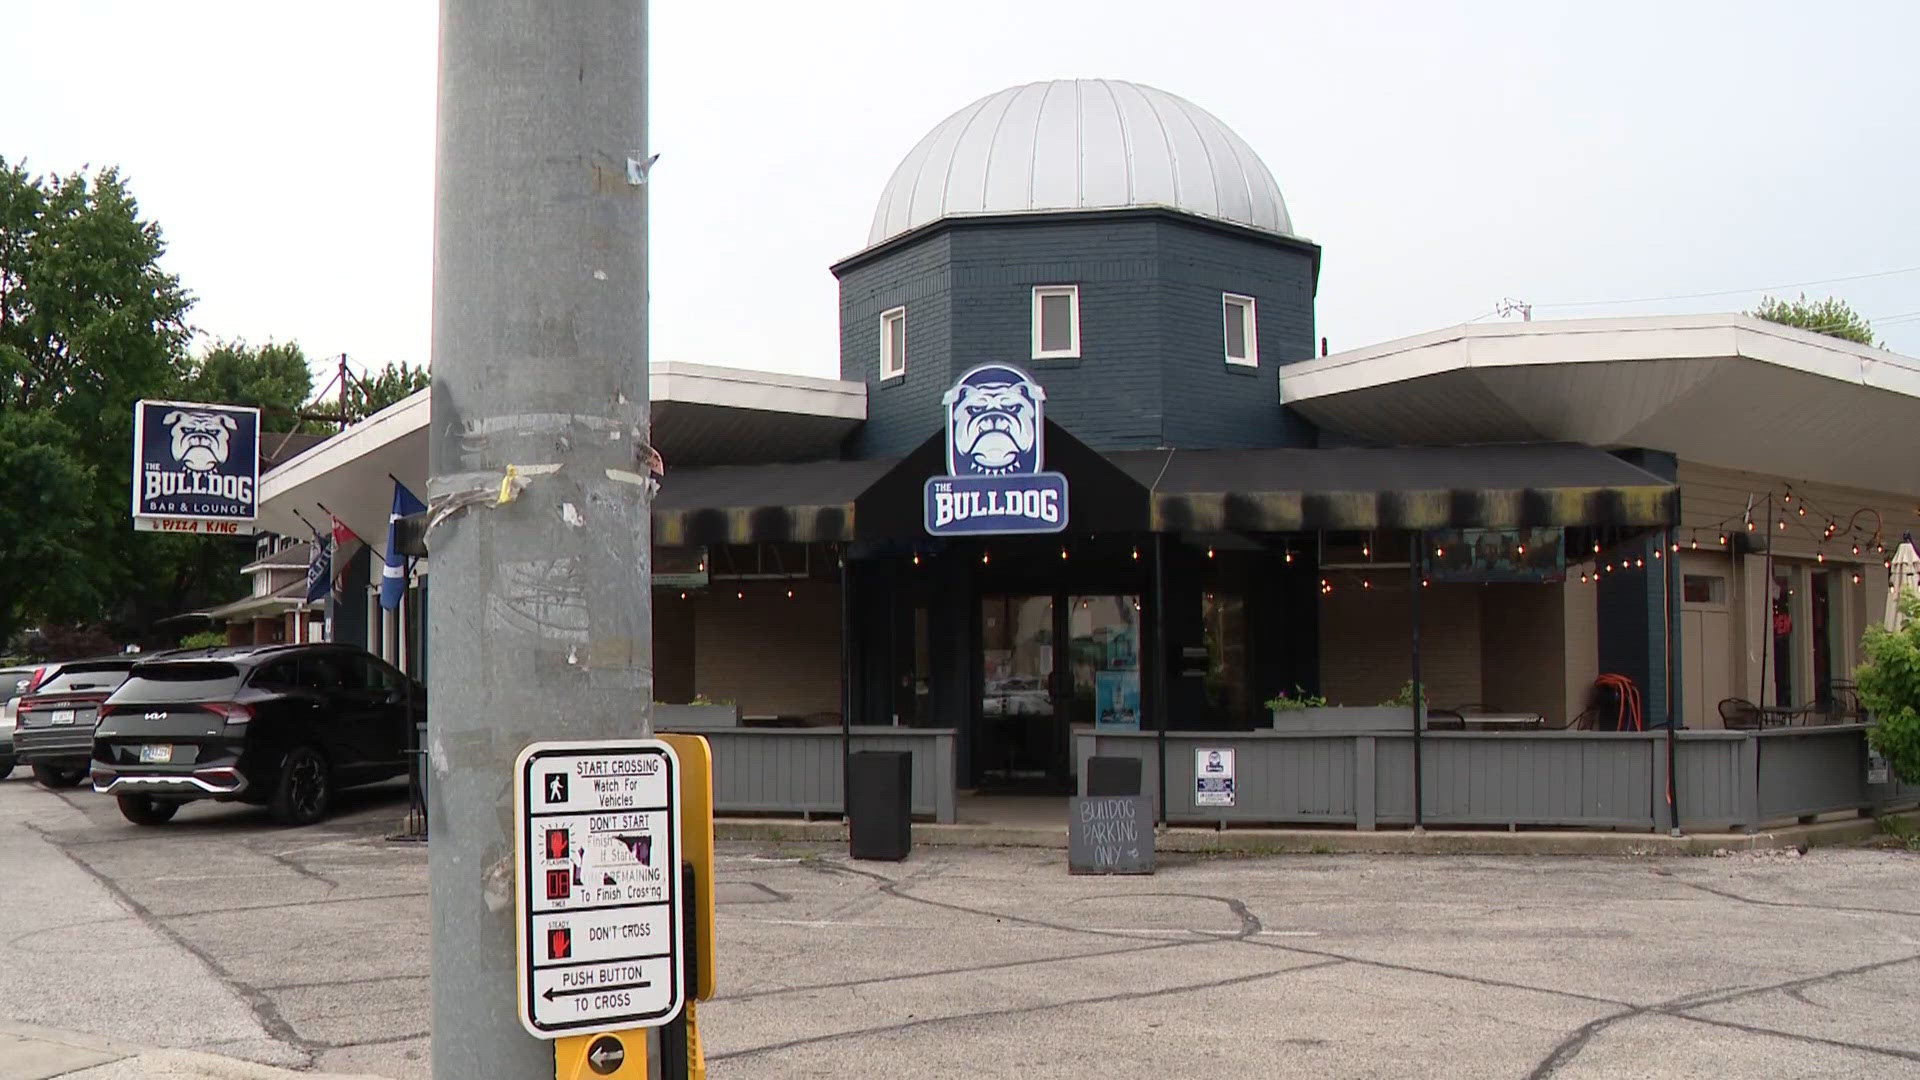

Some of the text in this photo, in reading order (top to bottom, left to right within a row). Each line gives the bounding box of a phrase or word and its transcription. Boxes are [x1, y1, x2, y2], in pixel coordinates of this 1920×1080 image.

[145, 463, 160, 471] THE
[145, 471, 252, 505] BULLDOG
[935, 483, 952, 492] THE
[150, 502, 246, 515] BAR & LOUNGE
[935, 489, 1058, 528] BULLDOG
[163, 520, 198, 532] PIZZA
[206, 522, 238, 534] KING
[577, 759, 659, 775] START CROSSING
[594, 778, 638, 793] Watch For
[600, 794, 633, 807] Vehicles
[590, 815, 649, 830] DON'T START
[588, 834, 613, 847] Finish
[1083, 820, 1138, 846] PARKING
[581, 889, 590, 902] To
[596, 887, 621, 901] Finish
[589, 923, 651, 941] DON'T CROSS
[563, 966, 642, 986] PUSH BUTTON
[575, 993, 631, 1011] TO CROSS
